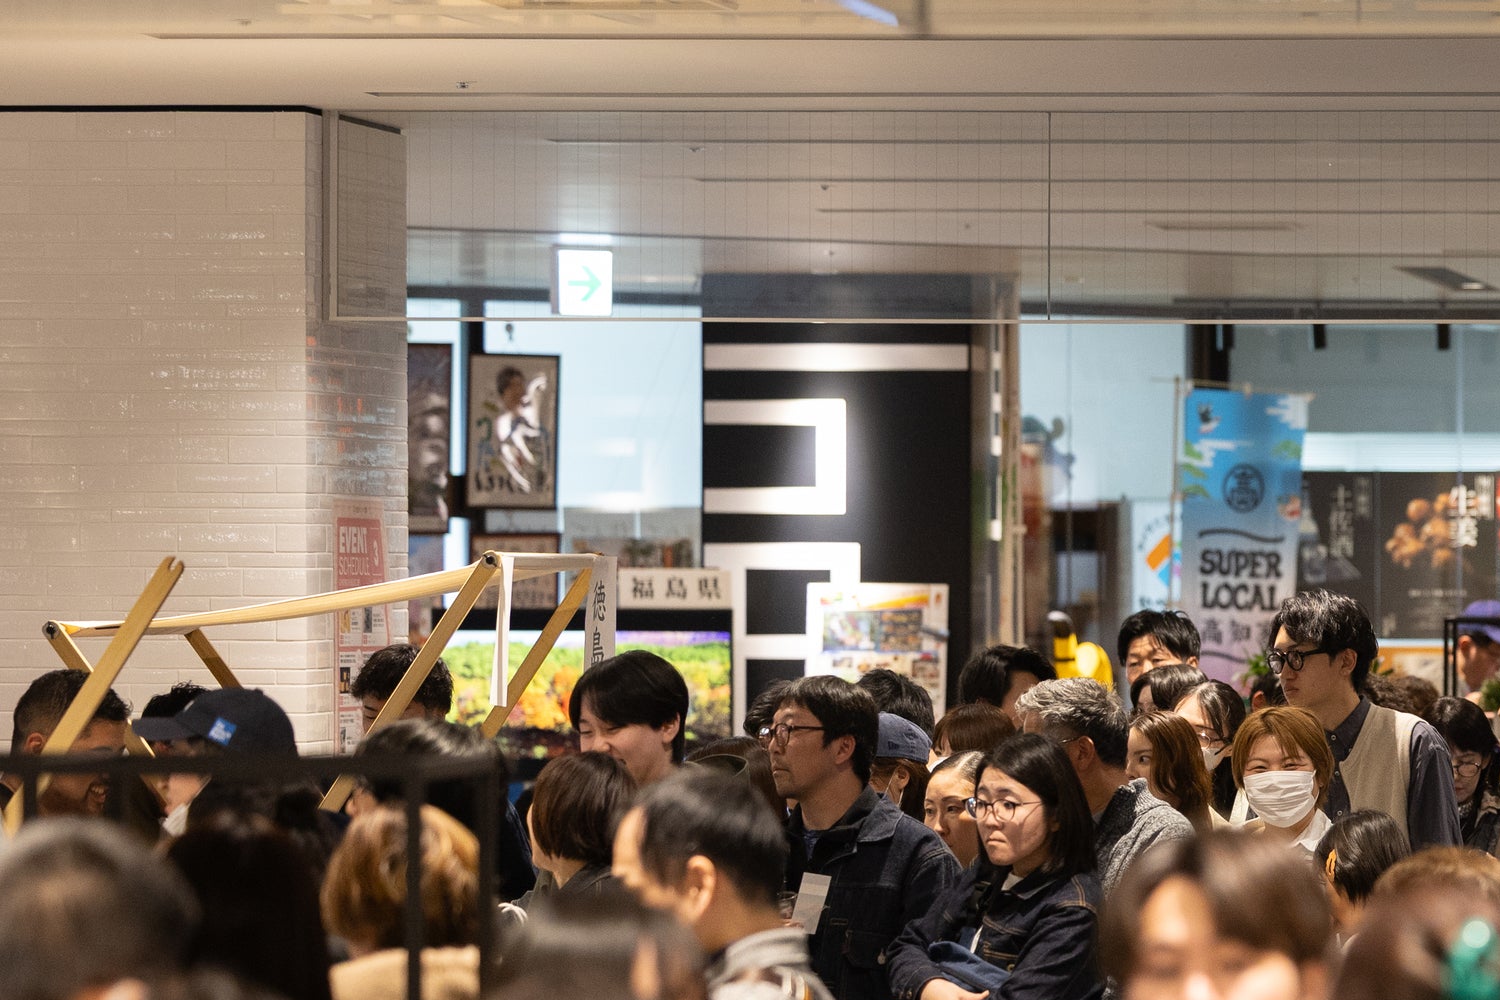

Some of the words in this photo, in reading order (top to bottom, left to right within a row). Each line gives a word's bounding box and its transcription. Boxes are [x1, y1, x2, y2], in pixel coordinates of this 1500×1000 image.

[339, 526, 368, 554] EVENT
[372, 540, 379, 568] 3
[338, 556, 370, 576] SCHEDULE
[1200, 550, 1282, 578] SUPER
[632, 576, 722, 600] 福島県
[1201, 581, 1276, 611] LOCAL
